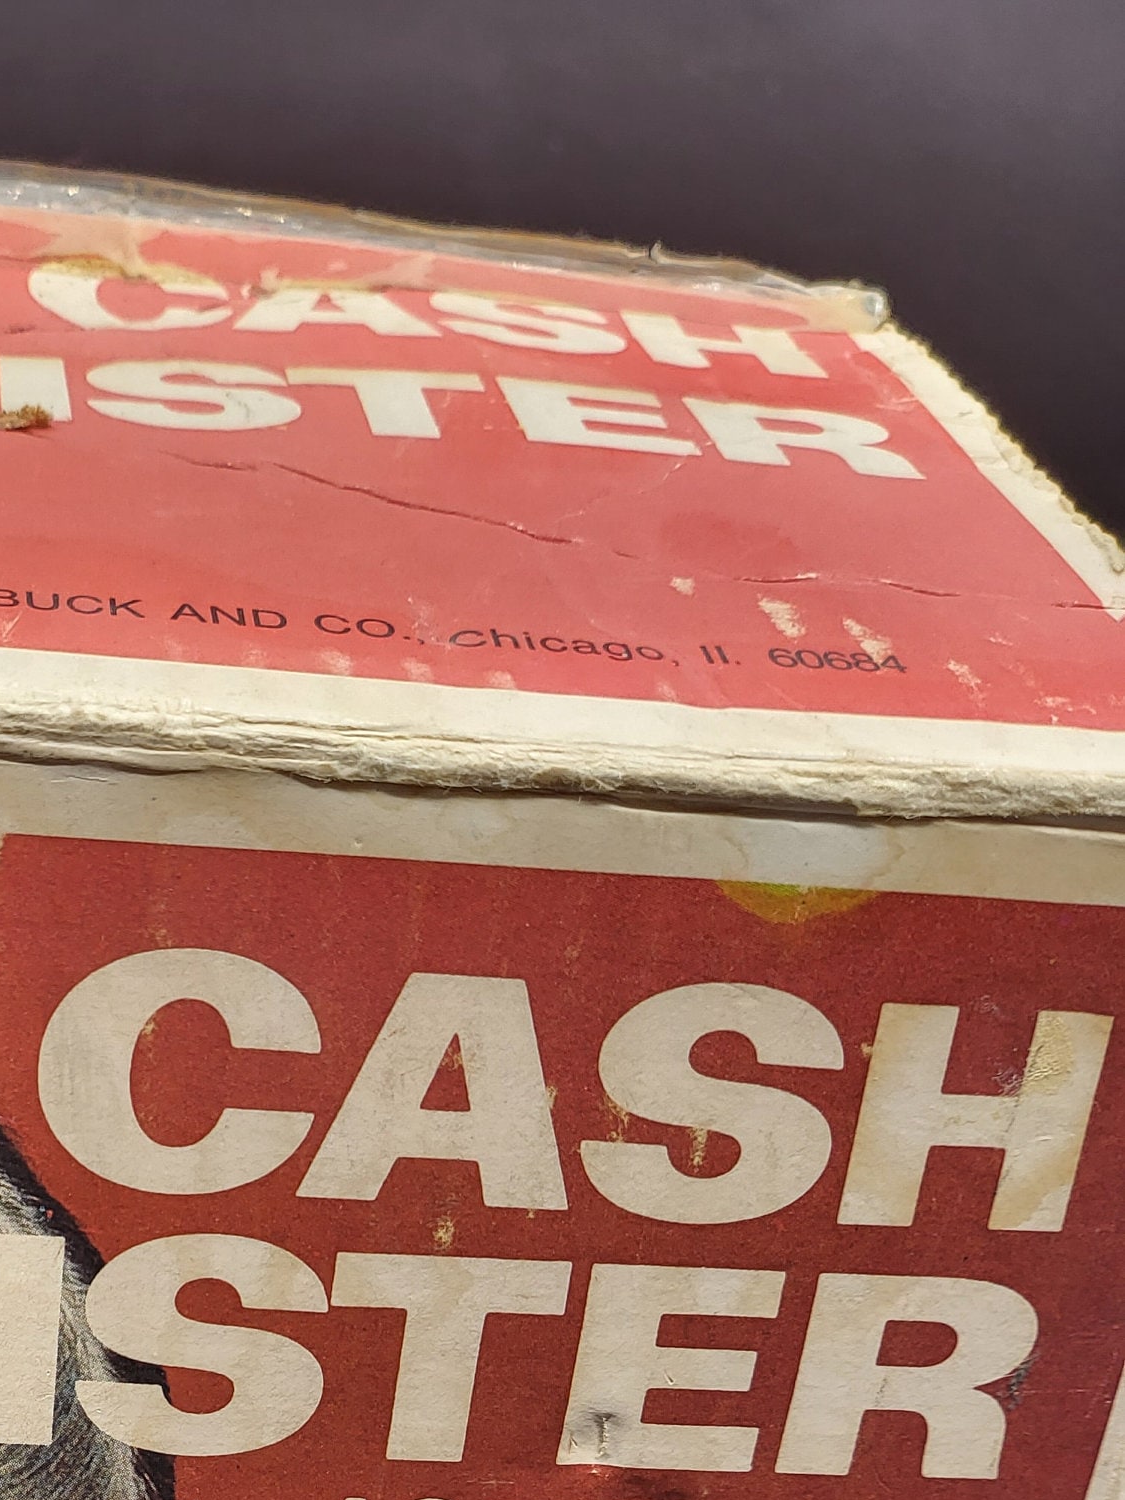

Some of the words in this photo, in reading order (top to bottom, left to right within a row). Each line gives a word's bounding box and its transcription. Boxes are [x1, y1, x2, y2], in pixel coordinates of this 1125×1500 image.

[27, 258, 829, 379] CASH
[170, 602, 287, 630] AND
[449, 628, 680, 668] Chicago,
[768, 646, 908, 675] 60684
[38, 946, 1115, 1232] CASH
